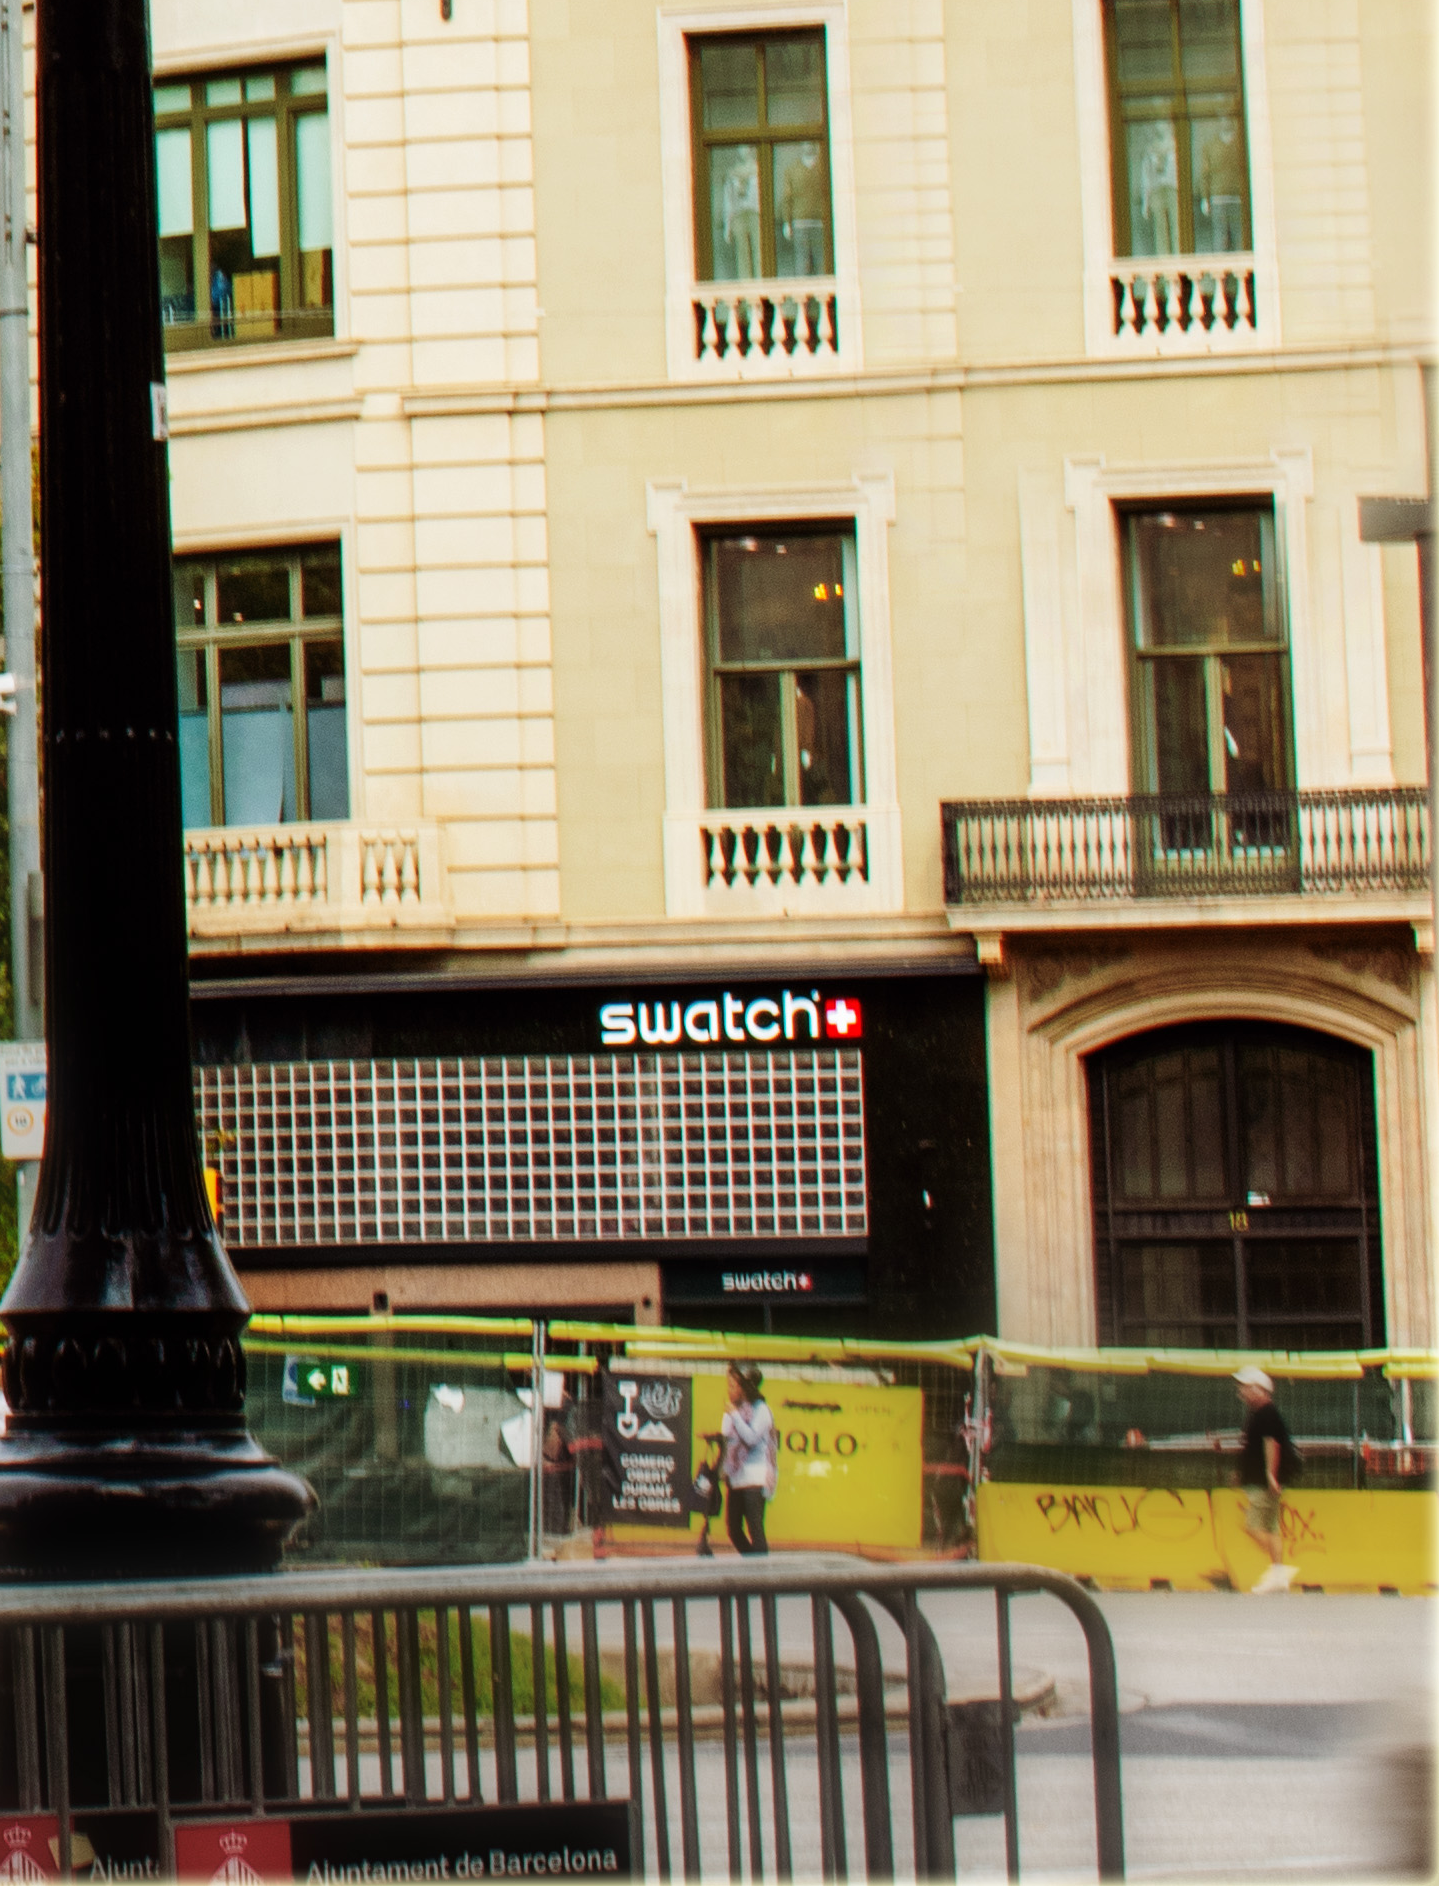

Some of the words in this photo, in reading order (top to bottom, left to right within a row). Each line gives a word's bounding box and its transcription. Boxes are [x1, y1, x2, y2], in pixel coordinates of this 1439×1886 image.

[600, 988, 820, 1045] swatch
[722, 1270, 797, 1291] swatch
[455, 1850, 484, 1880] de
[489, 1844, 618, 1877] Barcelona
